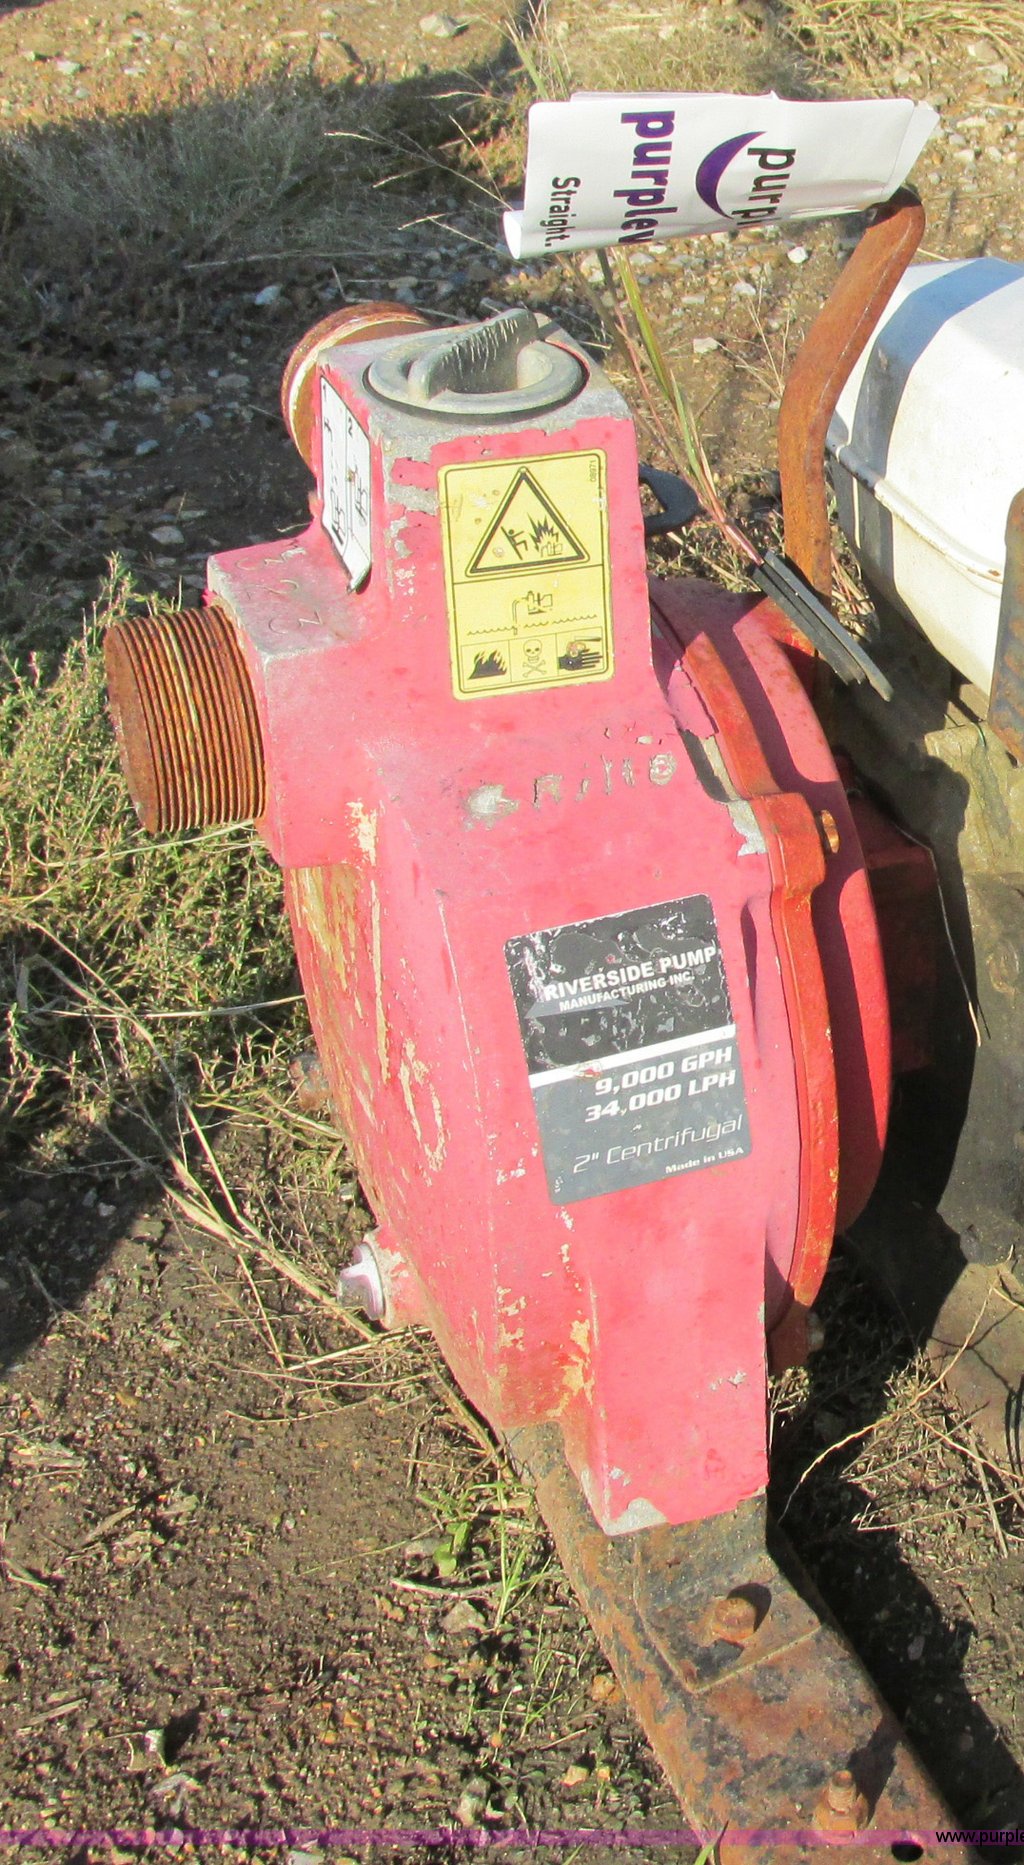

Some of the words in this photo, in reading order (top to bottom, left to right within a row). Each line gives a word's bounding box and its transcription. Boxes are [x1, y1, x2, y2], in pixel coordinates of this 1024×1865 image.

[539, 176, 581, 247] Straight.
[542, 961, 655, 1002] RIVERSIDE
[658, 946, 717, 974] PUMP
[559, 977, 668, 1012] MANUFACTURING
[668, 971, 695, 986] INC.
[585, 1083, 682, 1123] 34,000
[688, 1069, 736, 1096] LPH
[595, 1061, 675, 1096] 9,000
[681, 1046, 733, 1073] GPH
[573, 1152, 599, 1174] 2"
[606, 1114, 743, 1165] Centrifugal
[665, 1159, 700, 1174] Made
[703, 1153, 715, 1163] in
[718, 1146, 744, 1159] USA
